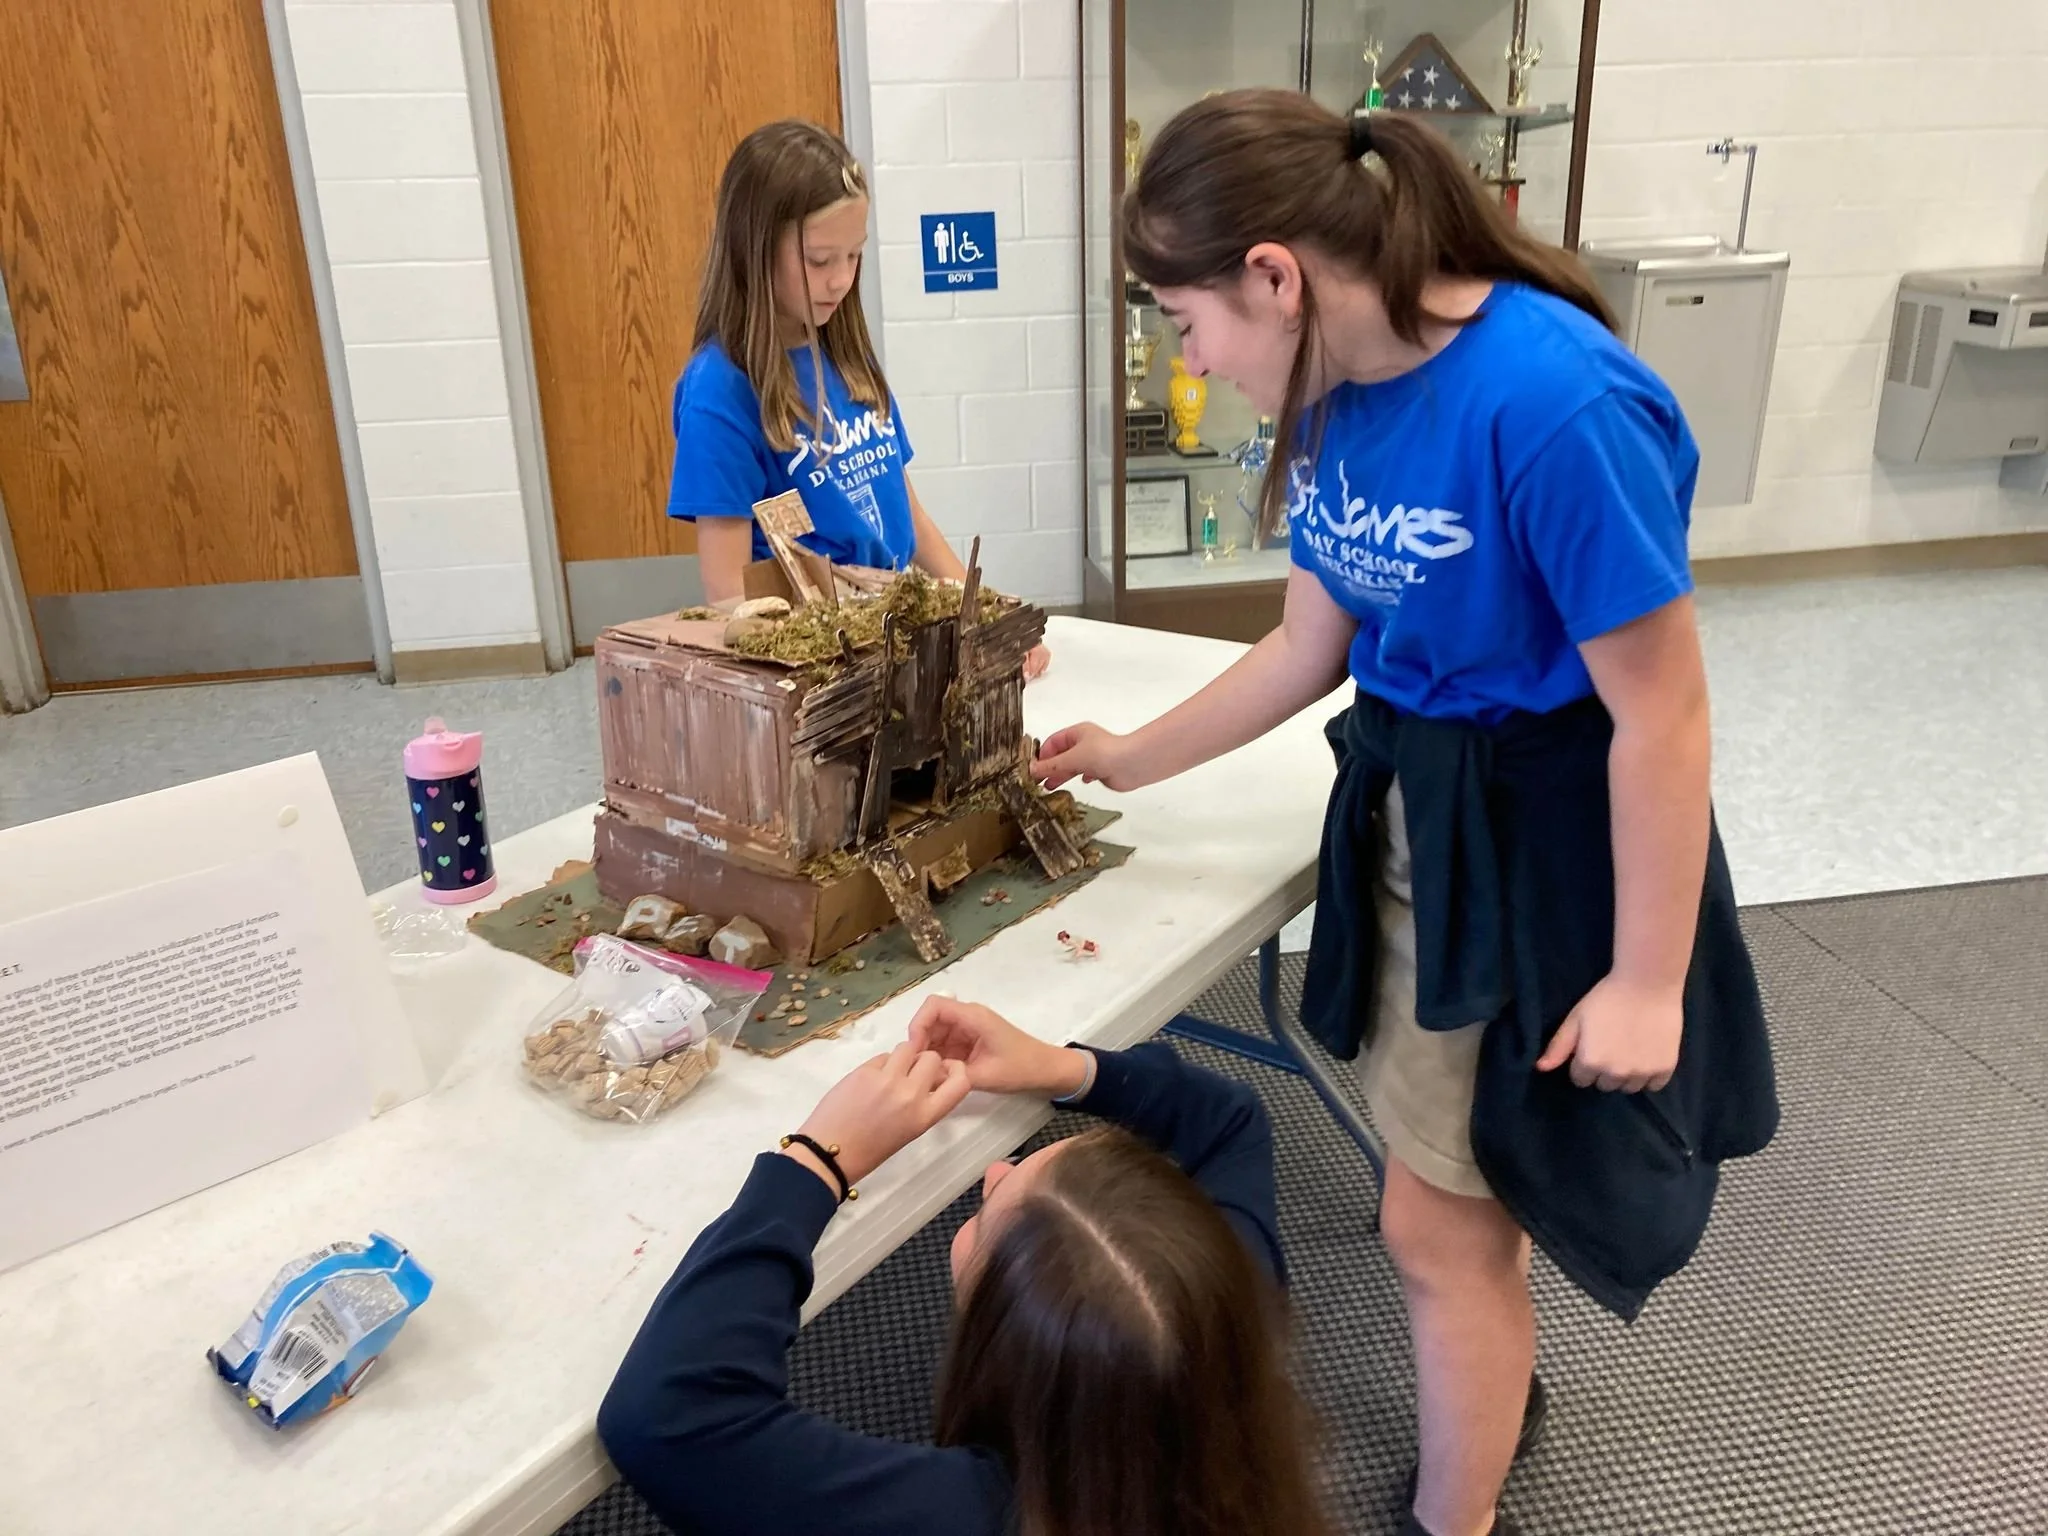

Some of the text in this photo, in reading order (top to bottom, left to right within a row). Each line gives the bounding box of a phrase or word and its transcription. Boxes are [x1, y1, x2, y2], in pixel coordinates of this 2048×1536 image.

[947, 272, 974, 284] BOYS
[838, 441, 897, 476] SCHOOL
[1319, 459, 1474, 560] James
[1340, 542, 1427, 584] SCHOOL
